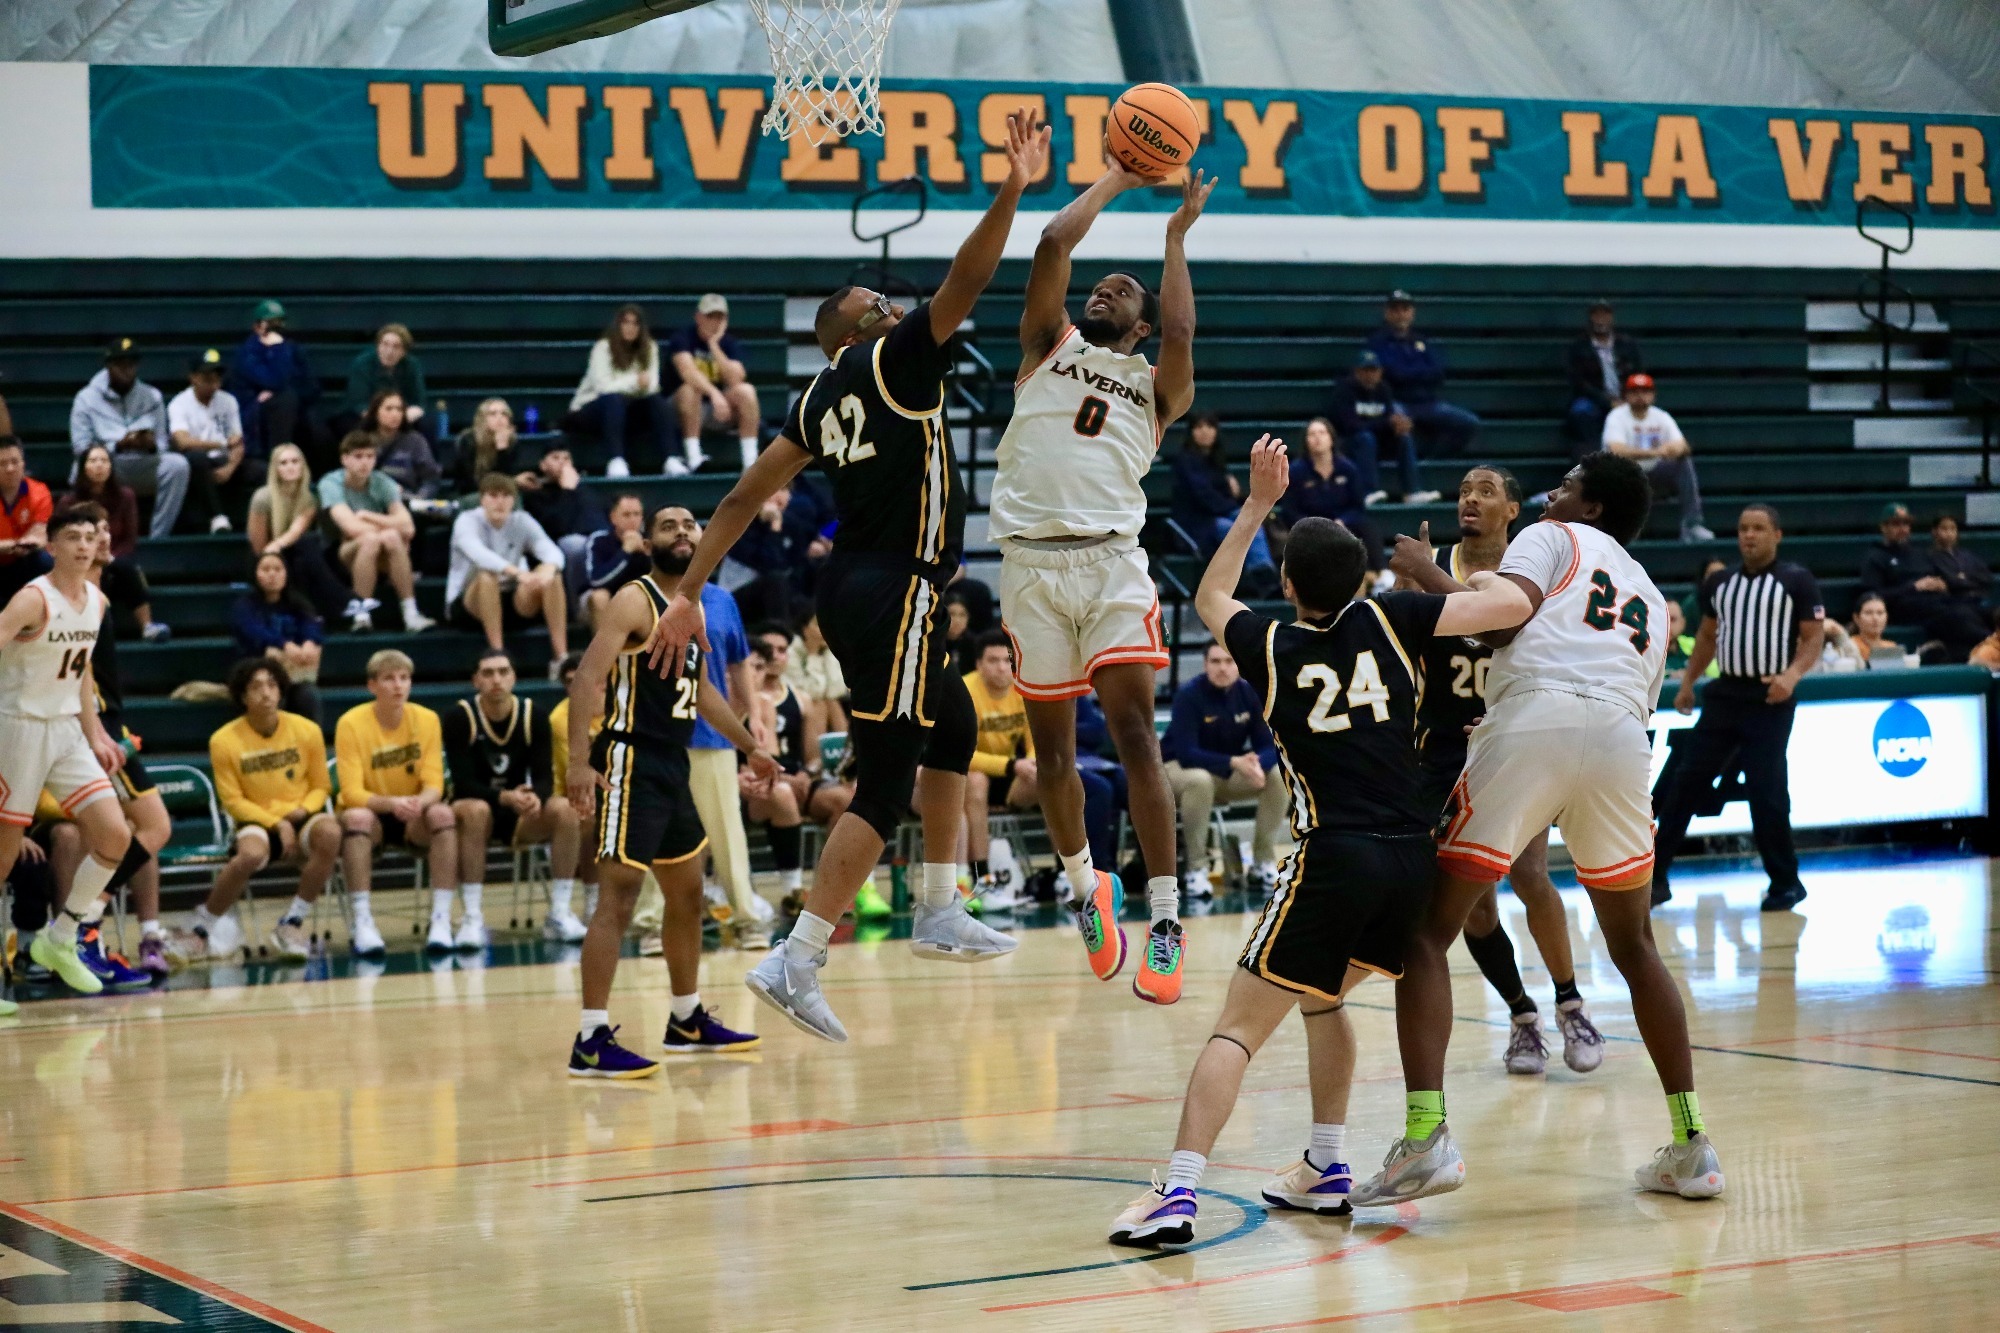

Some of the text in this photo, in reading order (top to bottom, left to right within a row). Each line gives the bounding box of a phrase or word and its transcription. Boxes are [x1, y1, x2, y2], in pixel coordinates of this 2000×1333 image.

[1128, 113, 1181, 160] Wilson
[1358, 104, 1508, 199] OF
[1561, 111, 1720, 204] LA
[1768, 118, 1994, 209] VER
[1049, 360, 1079, 380] LA
[820, 392, 877, 467] 42
[1073, 394, 1110, 438] 0
[1582, 568, 1651, 656] 24
[48, 631, 66, 643] LA
[57, 647, 88, 680] 14
[1450, 654, 1491, 698] 20
[1297, 650, 1391, 733] 24
[1877, 736, 1931, 763] NCAA
